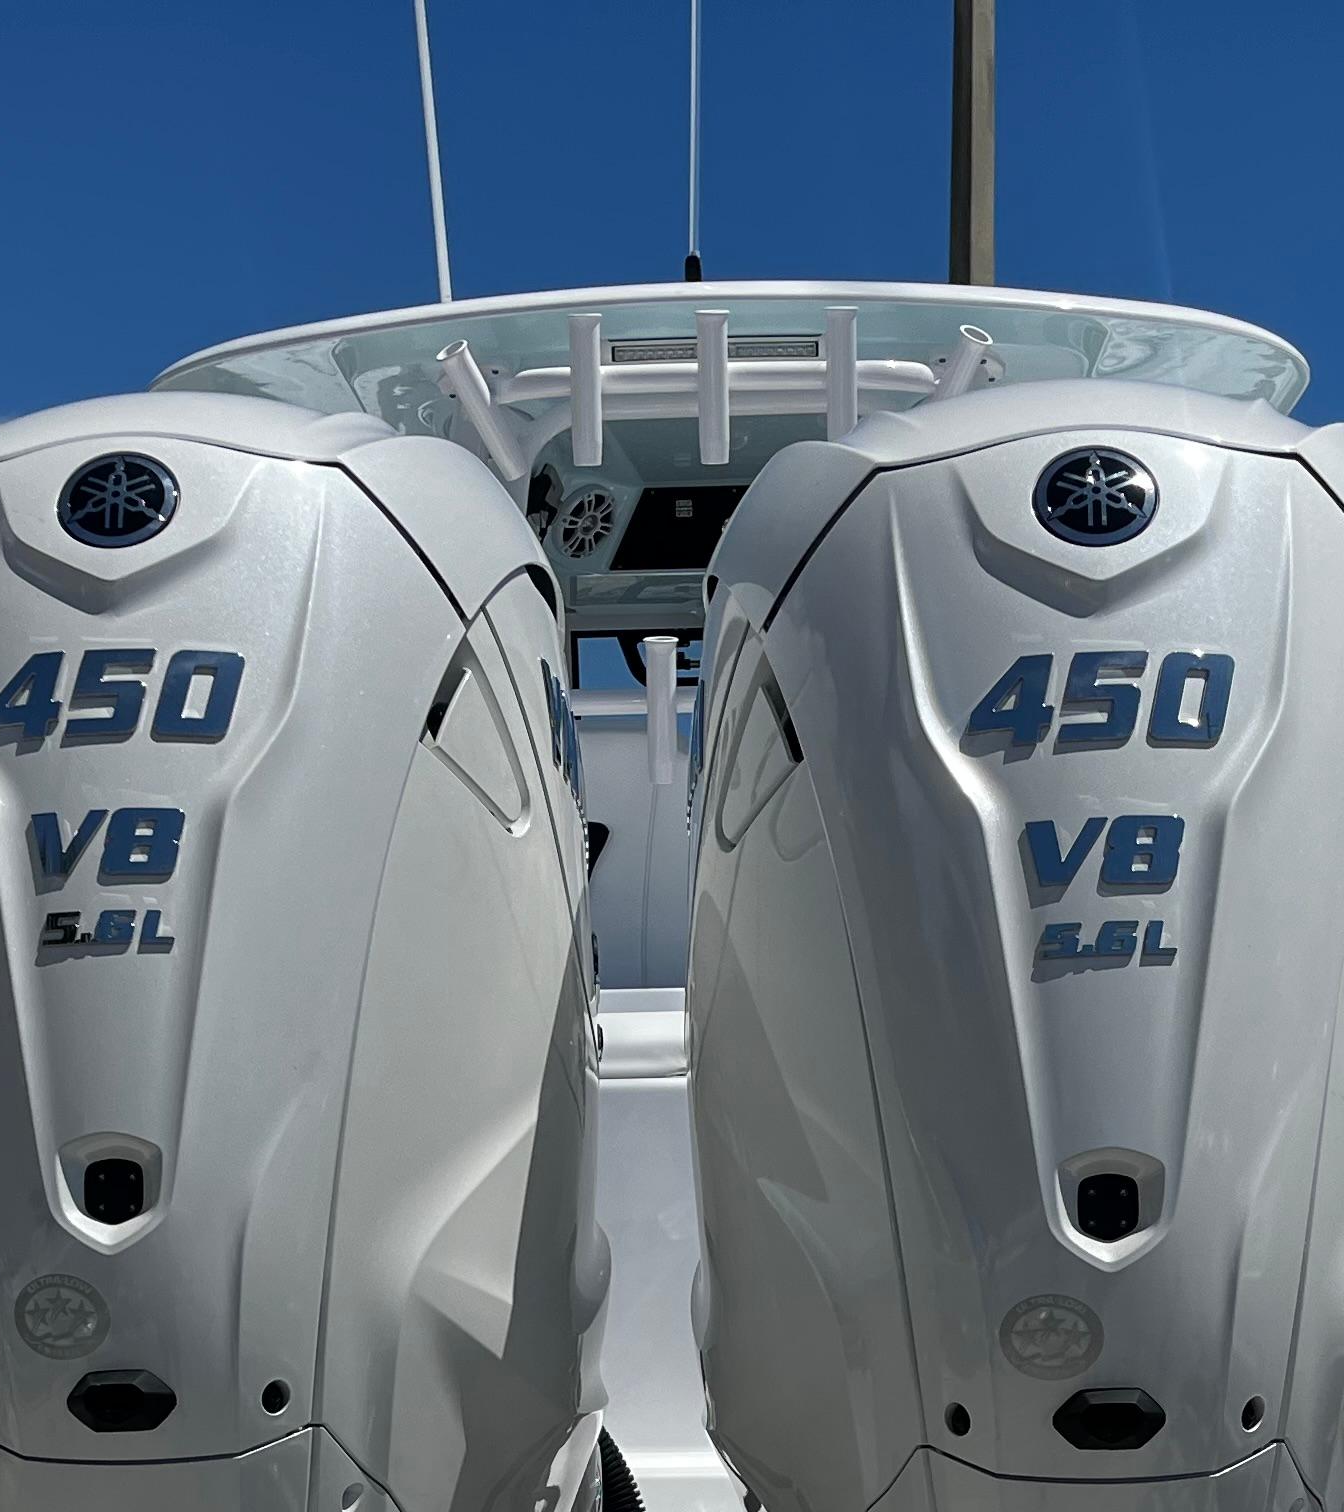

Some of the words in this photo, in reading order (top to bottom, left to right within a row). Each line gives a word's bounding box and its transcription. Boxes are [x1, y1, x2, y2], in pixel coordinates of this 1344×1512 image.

[966, 649, 1236, 752] 450
[29, 807, 185, 886] V8
[1022, 814, 1186, 896] V8
[41, 909, 175, 951] 5.6L
[1037, 920, 1178, 962] 5.6L
